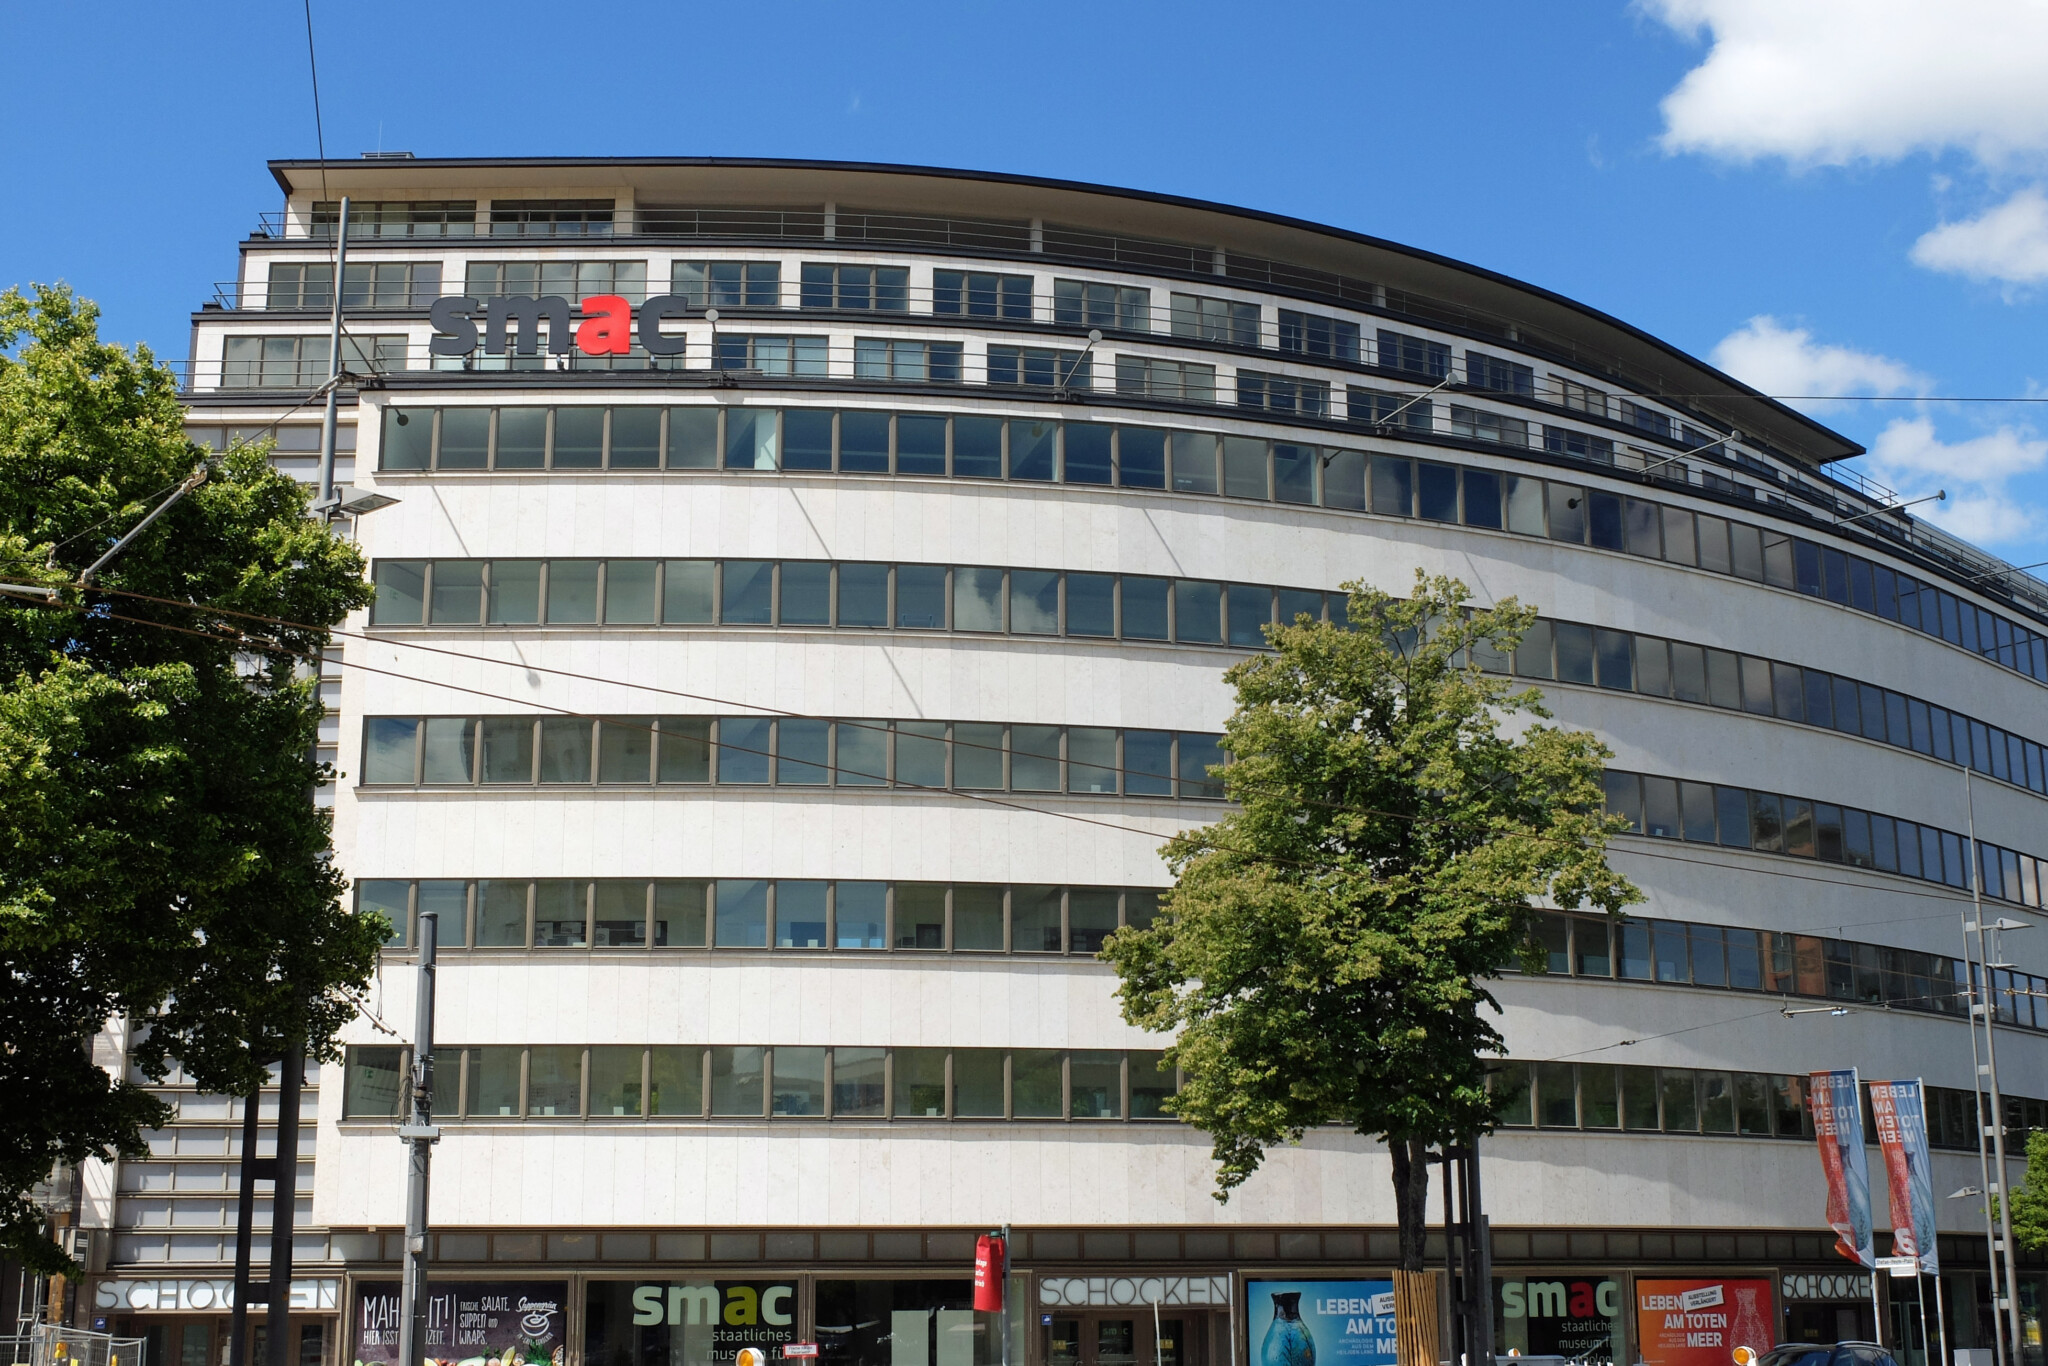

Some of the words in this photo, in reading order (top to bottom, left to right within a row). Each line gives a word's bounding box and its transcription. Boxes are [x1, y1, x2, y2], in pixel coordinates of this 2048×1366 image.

[429, 295, 688, 355] smac
[1040, 1277, 1229, 1306] SCHOCKEN
[1782, 1274, 1872, 1299] SCHOCKE
[632, 1285, 793, 1326] smac
[1316, 1299, 1373, 1315] LEBEN
[1501, 1281, 1619, 1319] smac
[1641, 1295, 1684, 1311] LEBEN
[363, 1294, 449, 1329] MAHIT!
[1345, 1319, 1373, 1335] AM
[1664, 1314, 1685, 1329] AM
[1685, 1313, 1727, 1329] TOTEN
[363, 1330, 380, 1345] HIER
[382, 1330, 399, 1345] ISST
[712, 1328, 792, 1342] staatliches
[1686, 1332, 1723, 1348] MEER
